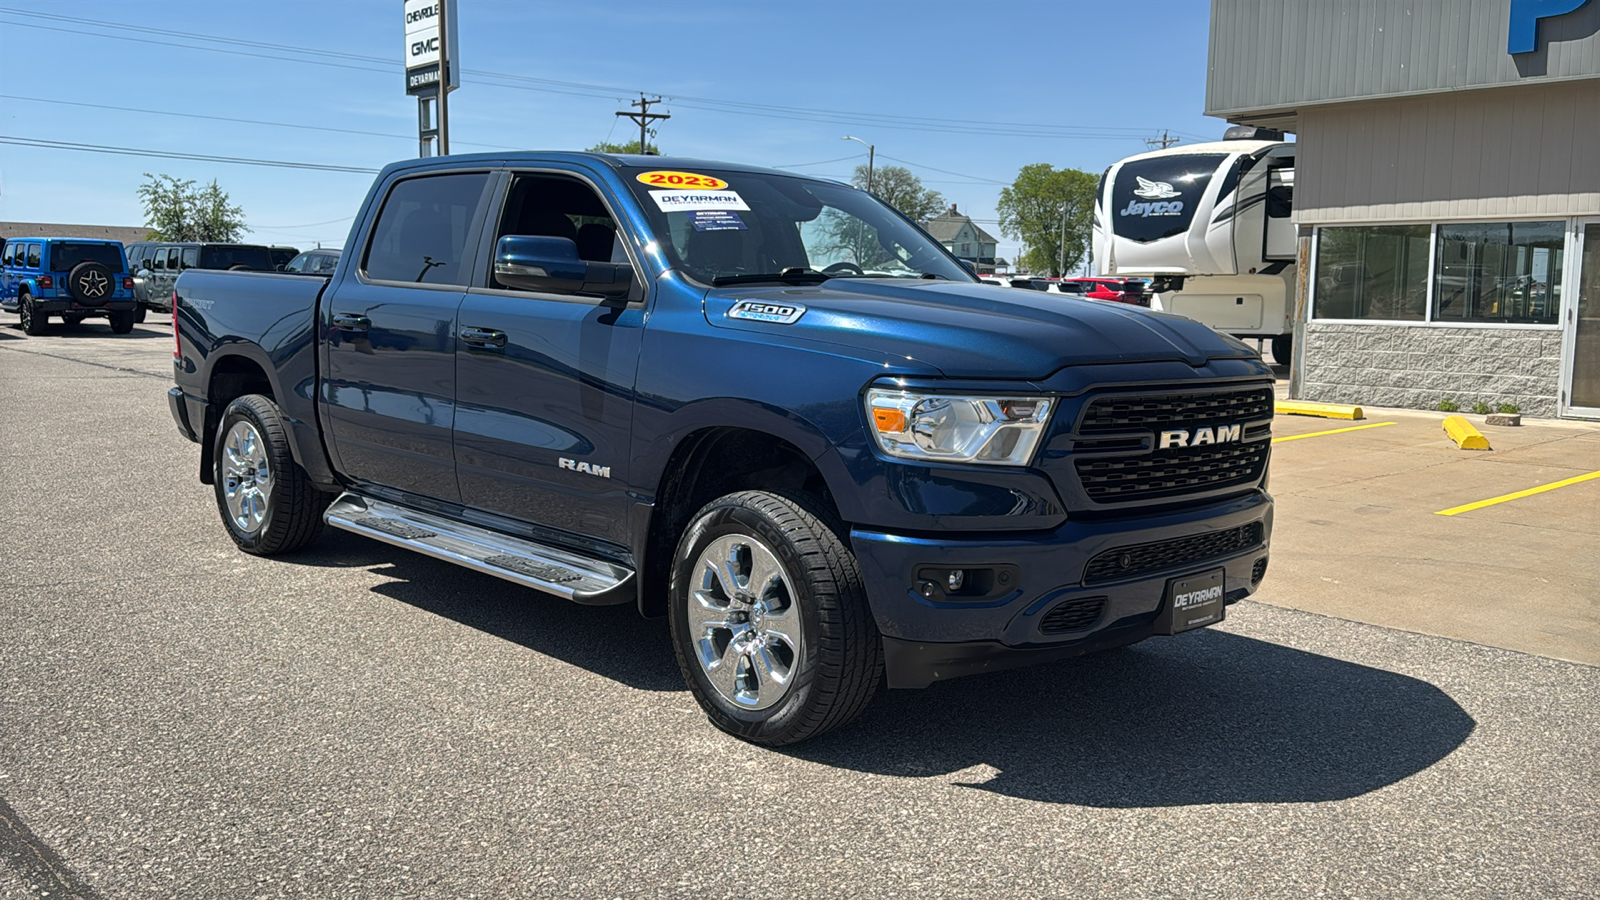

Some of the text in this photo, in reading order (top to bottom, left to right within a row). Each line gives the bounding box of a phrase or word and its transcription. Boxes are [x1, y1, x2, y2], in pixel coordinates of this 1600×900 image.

[406, 4, 439, 24] CHEVROLE
[411, 37, 439, 57] GMC
[649, 174, 719, 187] 2023
[661, 195, 737, 203] DEYARMAN
[1120, 200, 1184, 217] Jayco
[744, 303, 794, 315] 1500
[1159, 424, 1241, 449] RAM
[558, 457, 611, 478] RAM
[1174, 585, 1223, 608] DEYARMAN
